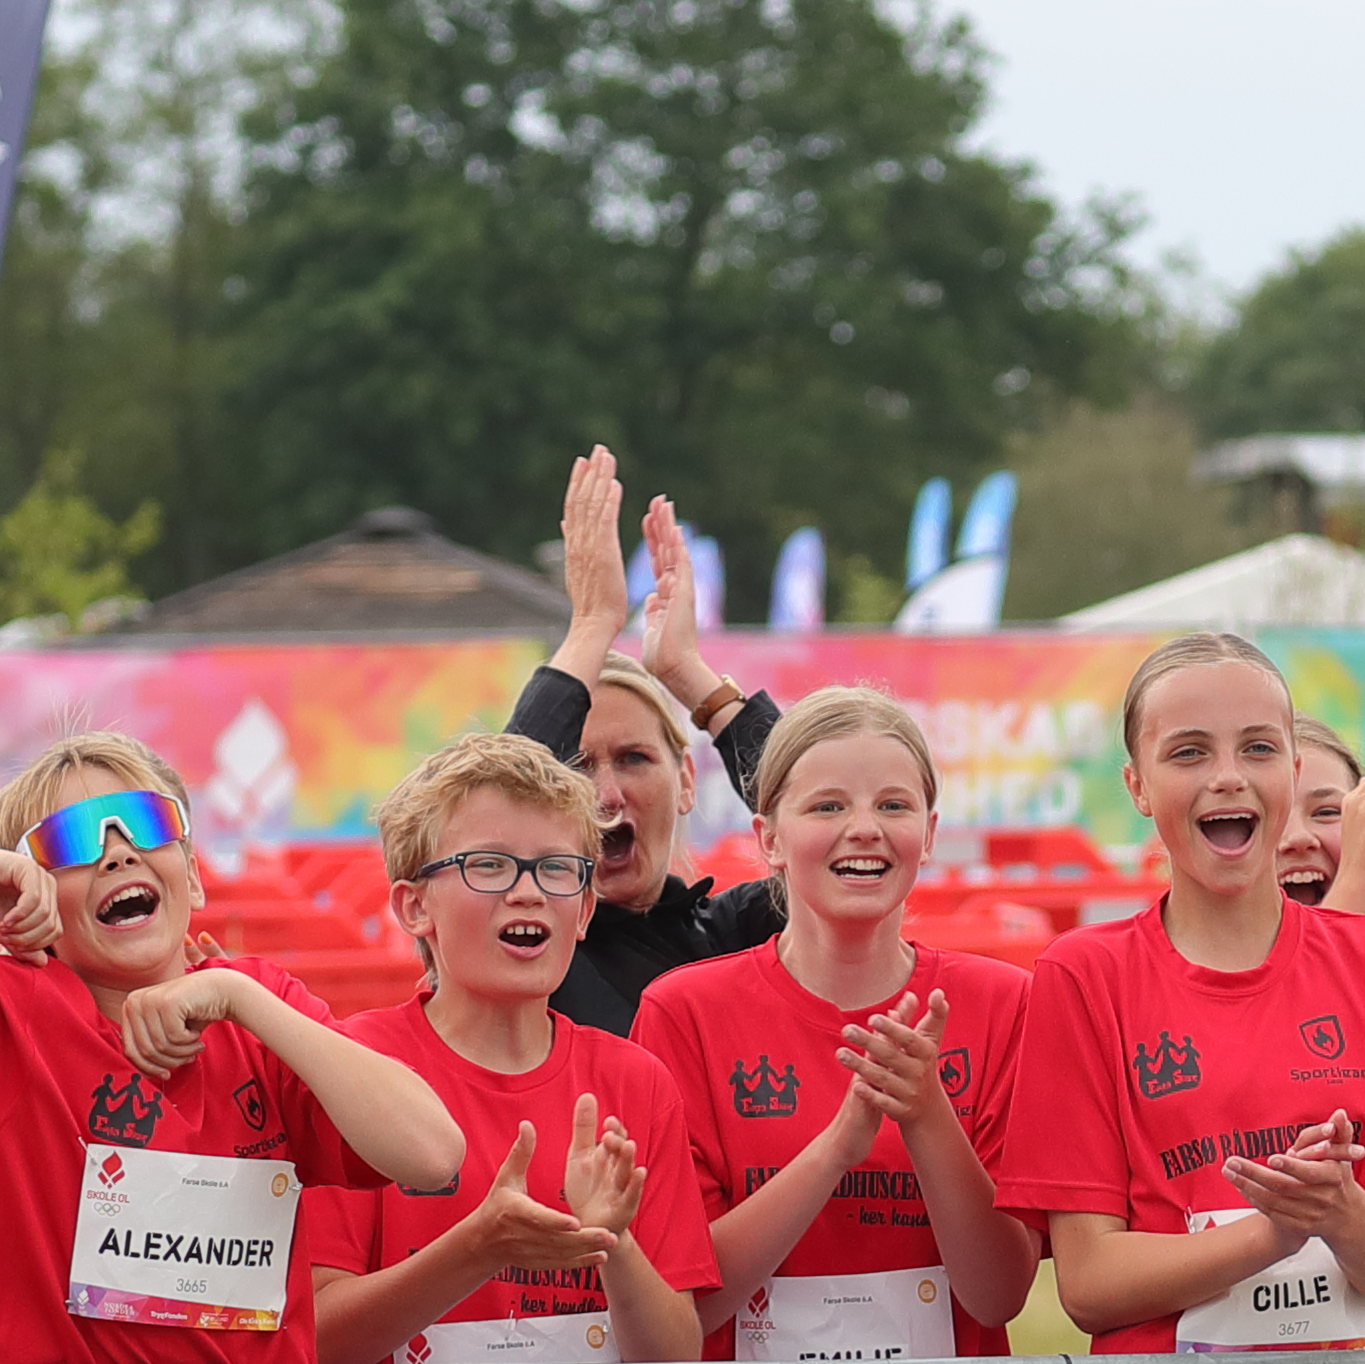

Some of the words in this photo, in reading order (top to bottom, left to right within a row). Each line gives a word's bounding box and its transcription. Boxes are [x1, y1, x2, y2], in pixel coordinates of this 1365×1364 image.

[1160, 1134, 1217, 1180] FARSØ
[86, 1189, 116, 1202] SKOLE
[118, 1193, 130, 1203] OL
[98, 1228, 274, 1267] ALEXANDER
[176, 1279, 207, 1293] 3665
[1252, 1275, 1331, 1312] CILLE
[739, 1321, 762, 1330] SKOLE
[1278, 1320, 1310, 1336] 3677
